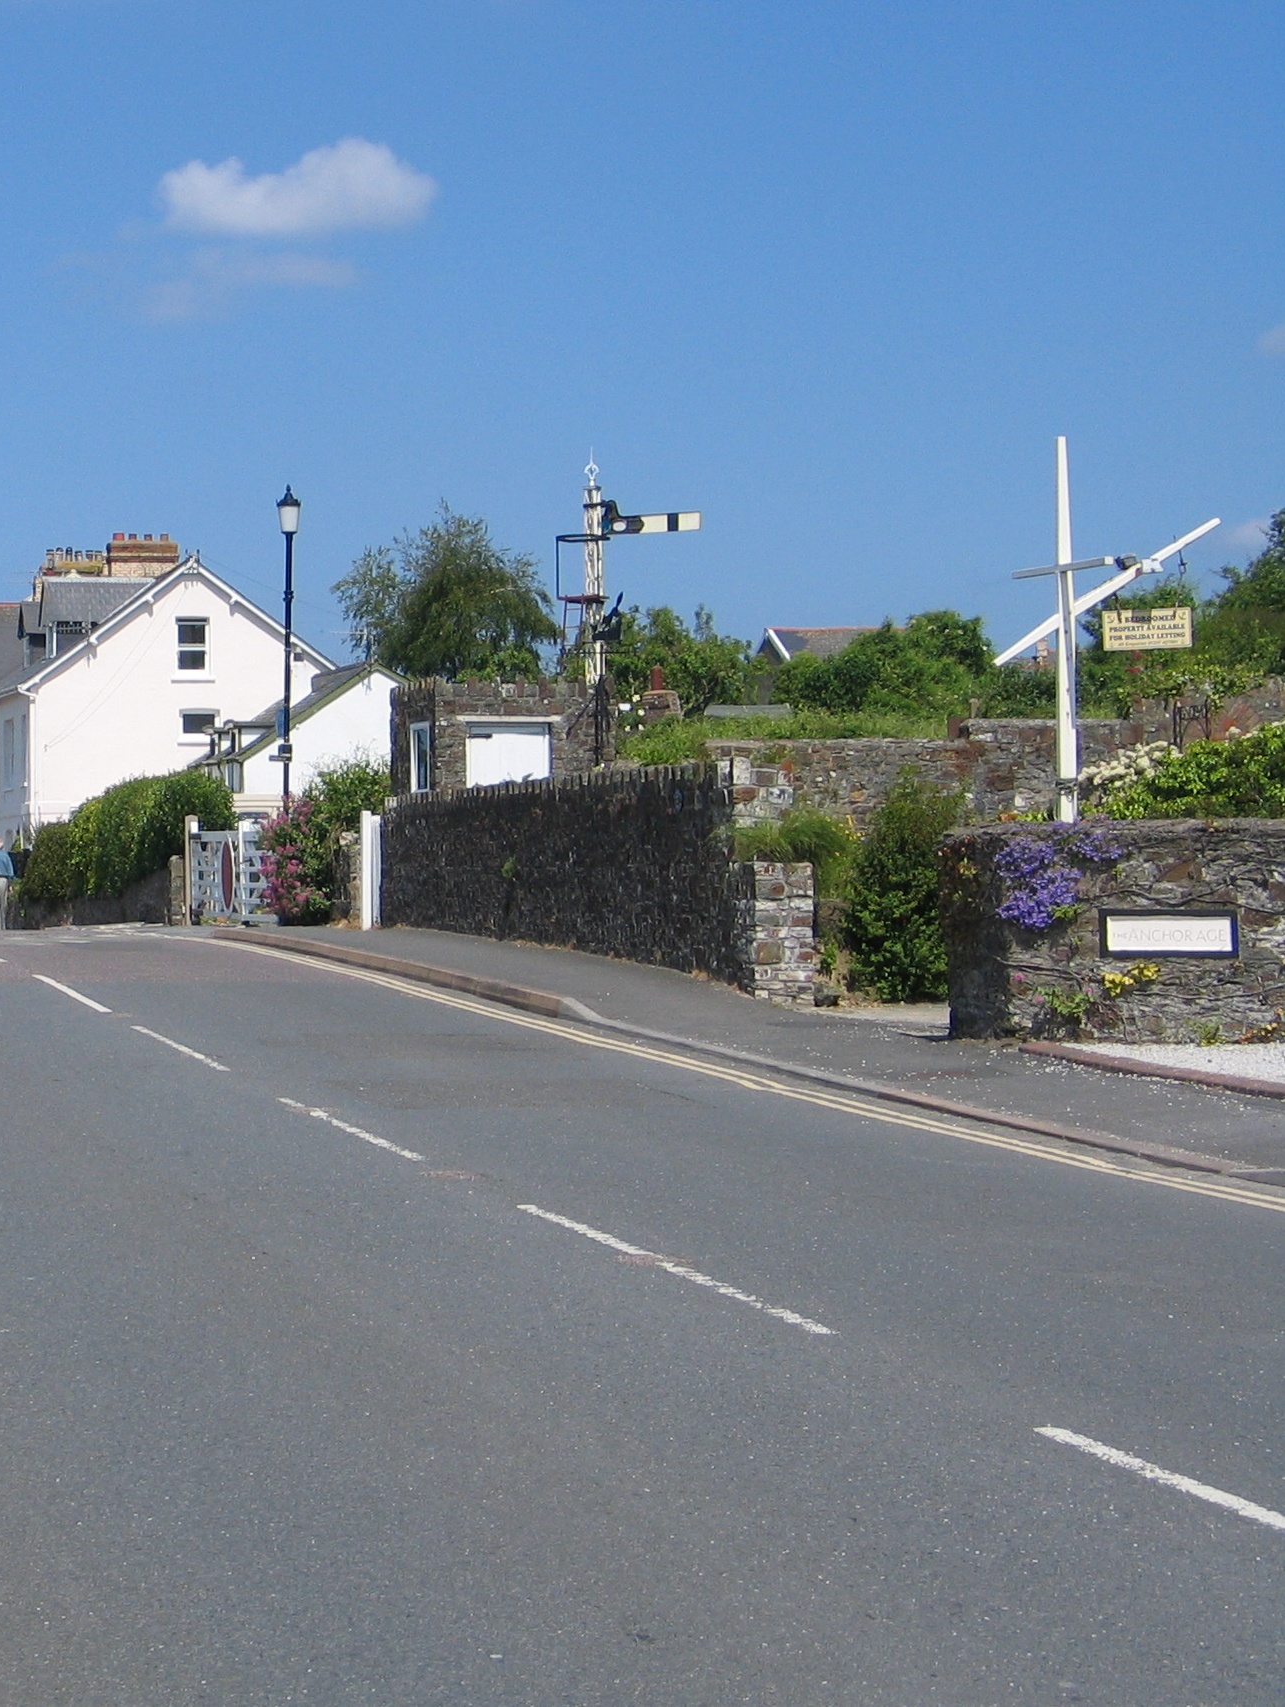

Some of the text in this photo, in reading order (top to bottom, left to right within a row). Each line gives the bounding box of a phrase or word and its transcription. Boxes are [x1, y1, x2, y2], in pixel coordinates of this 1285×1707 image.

[1109, 623, 1185, 633] PROPERTY AVAILABLE
[1112, 930, 1128, 939] THE
